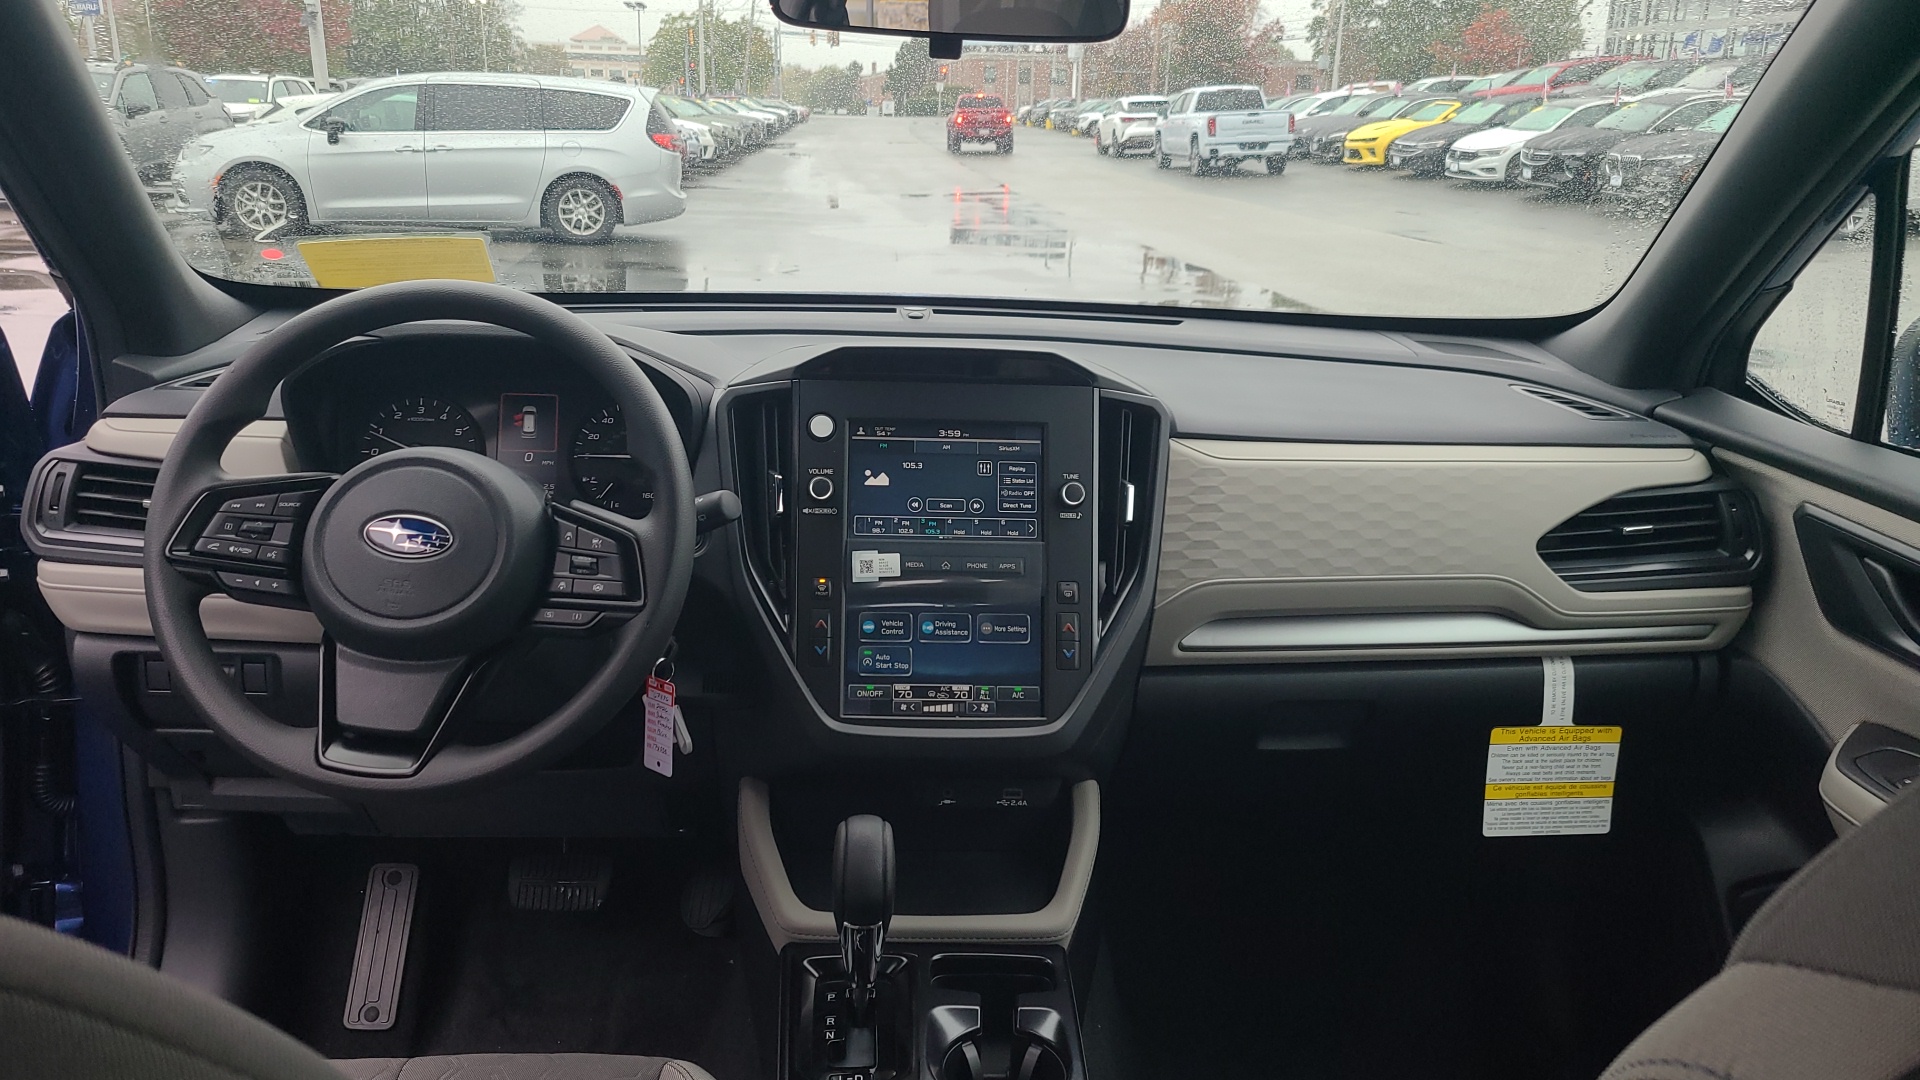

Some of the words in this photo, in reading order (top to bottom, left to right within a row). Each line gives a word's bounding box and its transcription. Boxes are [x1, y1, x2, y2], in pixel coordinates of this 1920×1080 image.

[524, 452, 534, 463] 0
[826, 1017, 835, 1025] R
[825, 1031, 835, 1039] N
